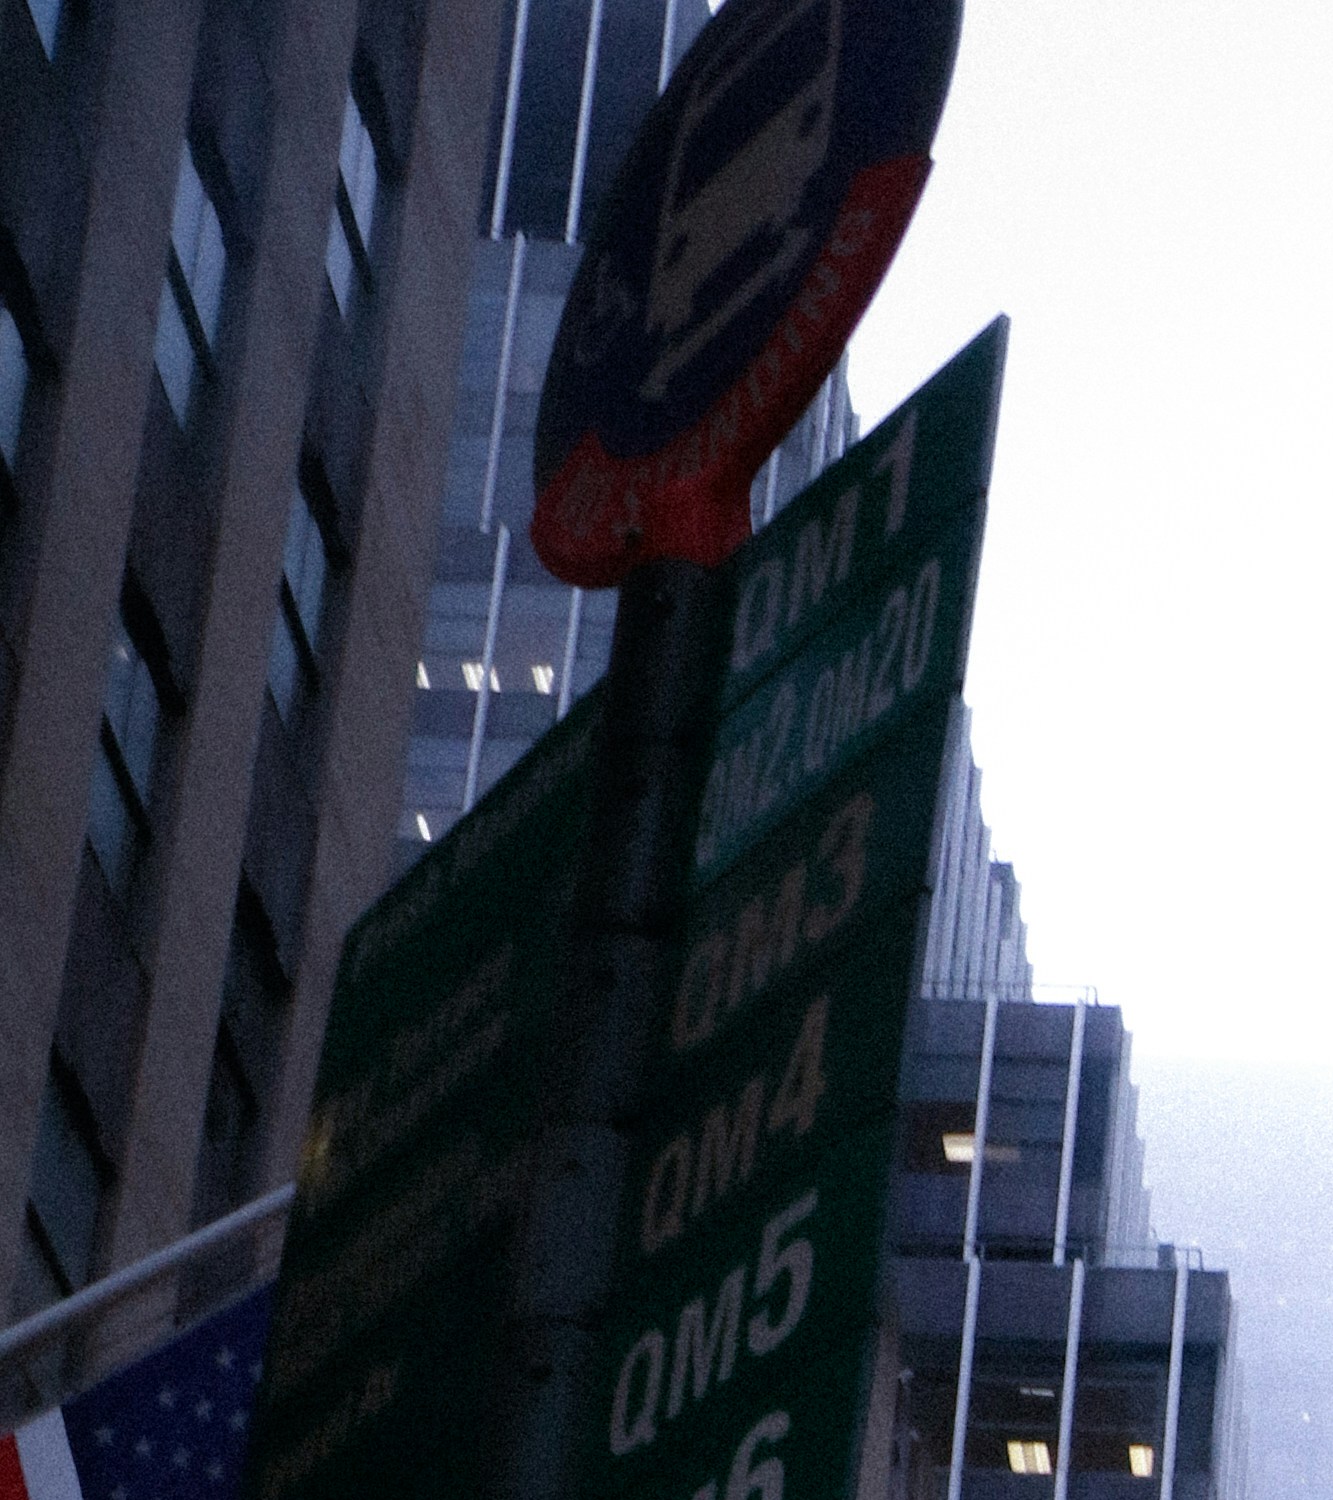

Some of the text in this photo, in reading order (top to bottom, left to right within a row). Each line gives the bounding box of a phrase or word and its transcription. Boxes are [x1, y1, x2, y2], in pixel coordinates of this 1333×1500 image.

[674, 794, 873, 1051] QM3
[640, 995, 829, 1254] QM4
[611, 1191, 818, 1456] QM5
